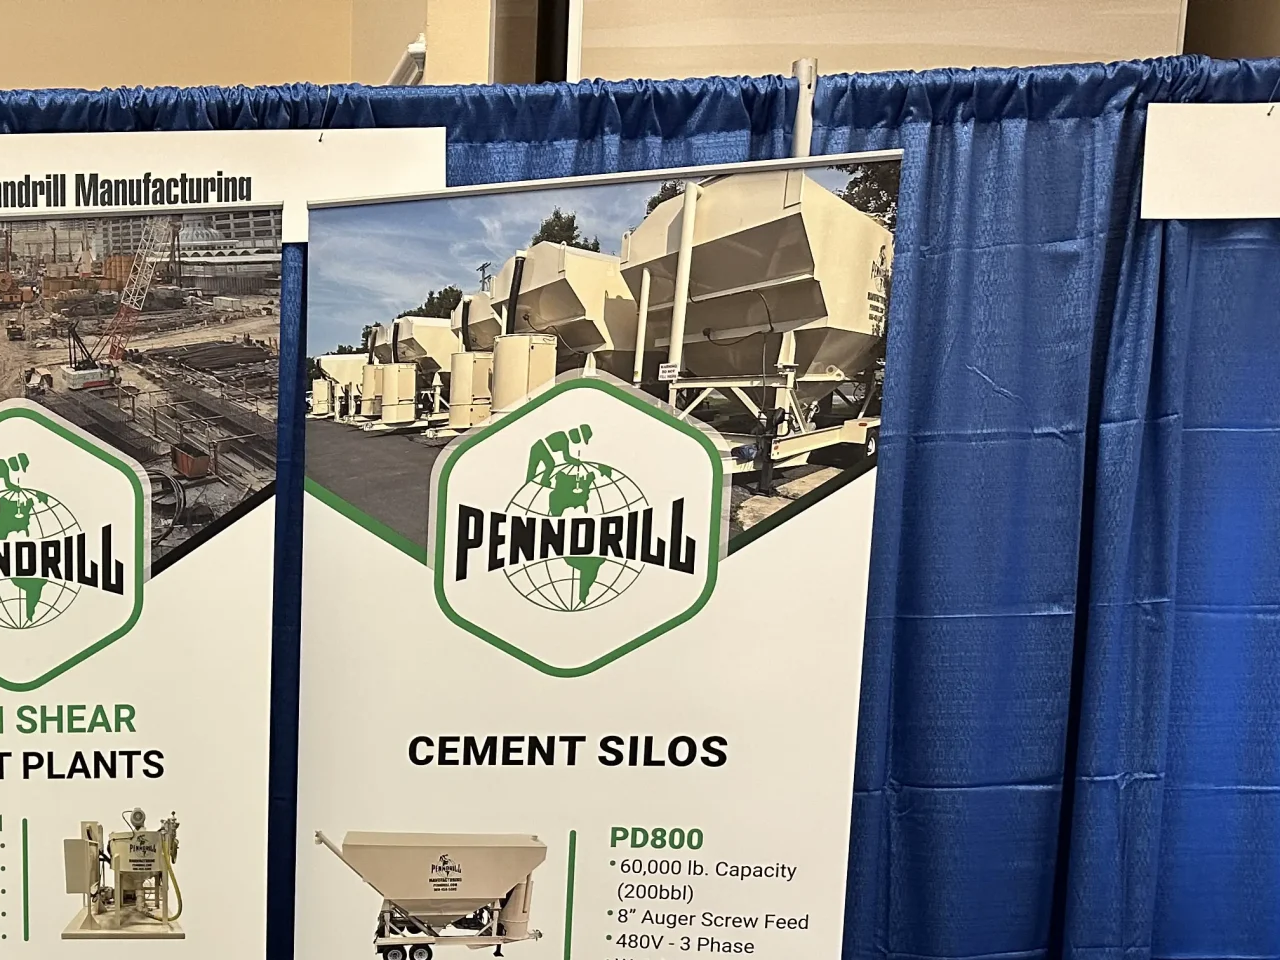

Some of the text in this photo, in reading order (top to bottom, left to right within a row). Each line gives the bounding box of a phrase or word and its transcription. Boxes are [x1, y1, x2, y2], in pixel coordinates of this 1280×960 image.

[74, 169, 252, 208] Manufacturing
[455, 496, 696, 582] PENNDRILL
[16, 704, 137, 734] SHEAR
[22, 749, 165, 780] PLANTS
[408, 735, 728, 768] CEMENT SILOS
[609, 826, 704, 851] PD800
[620, 858, 797, 882] 60,000 lb. Capacity
